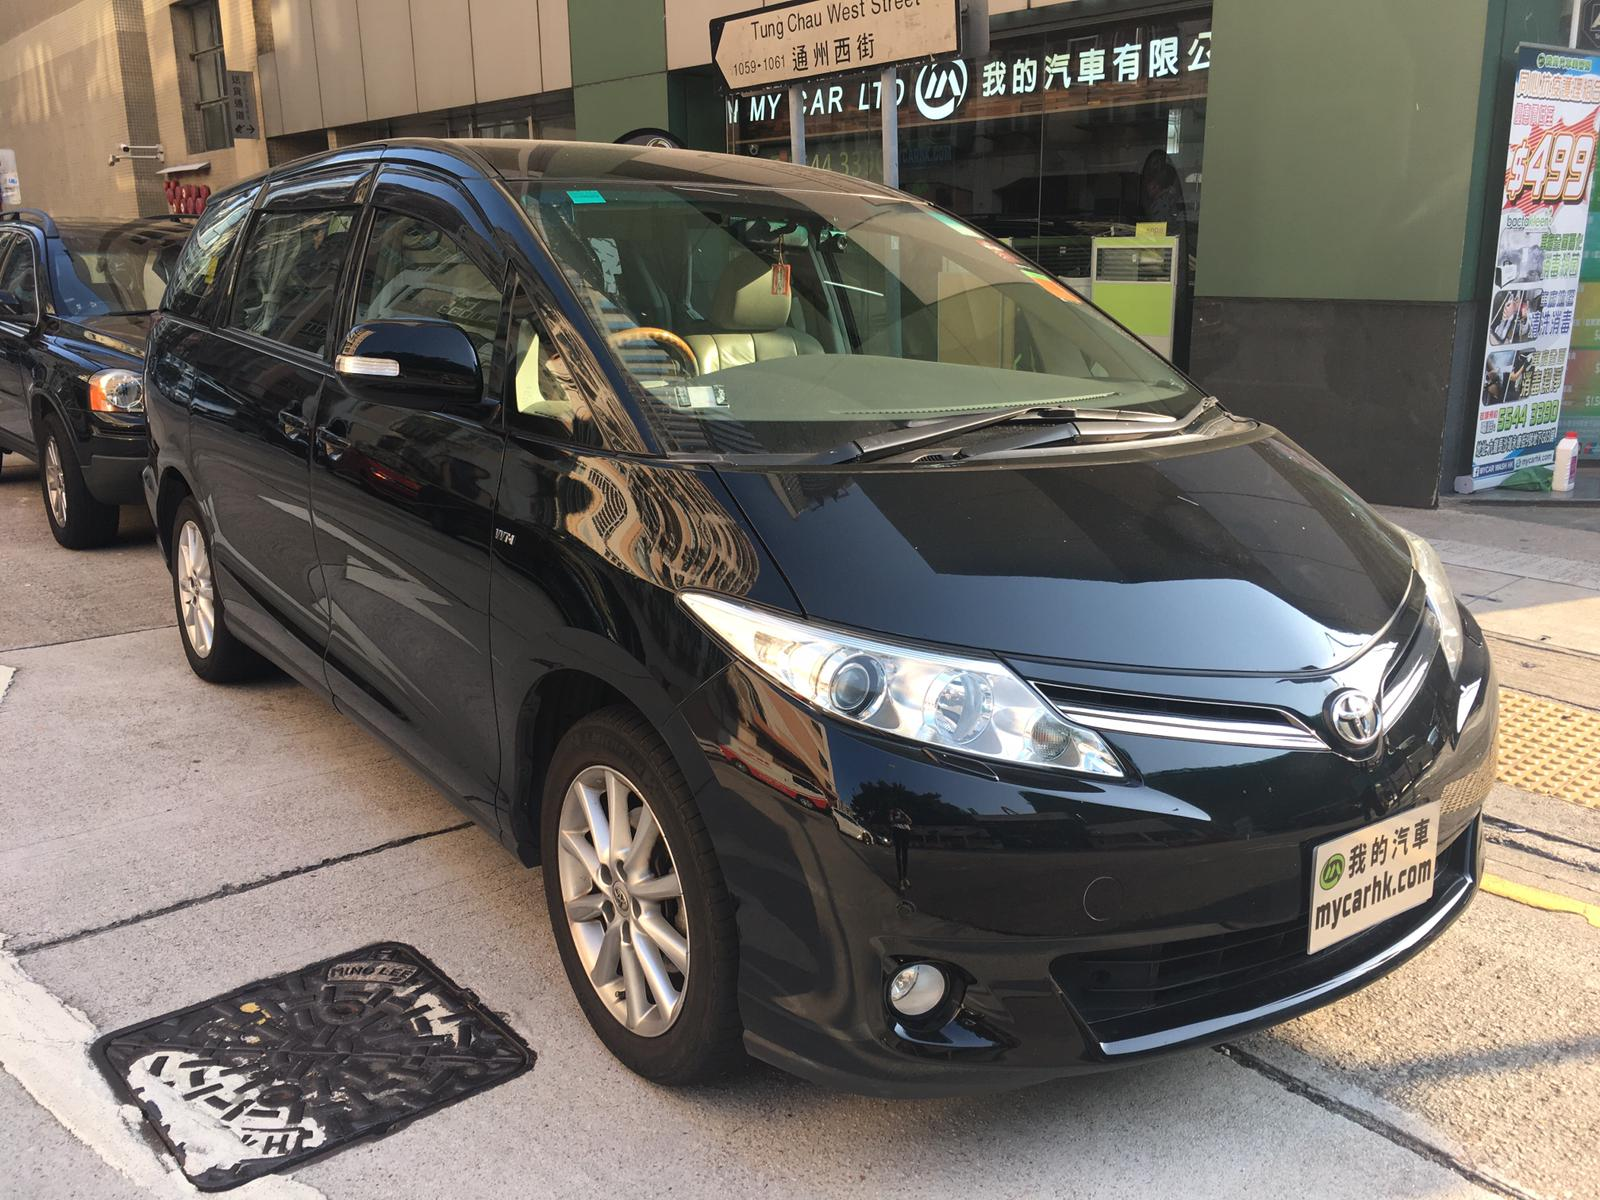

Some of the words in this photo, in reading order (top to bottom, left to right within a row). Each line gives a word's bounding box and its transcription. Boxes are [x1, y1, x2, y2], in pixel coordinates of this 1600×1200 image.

[751, 21, 784, 40] Tung
[788, 13, 822, 33] Chau
[827, 0, 865, 25] West
[792, 32, 875, 72] 通州西街
[750, 93, 782, 121] MY
[1506, 131, 1595, 202] $499
[1497, 403, 1528, 432] 5544
[1529, 400, 1559, 426] 3390
[1348, 817, 1430, 879] 我的汽車
[1315, 858, 1432, 930] mycarhk.com
